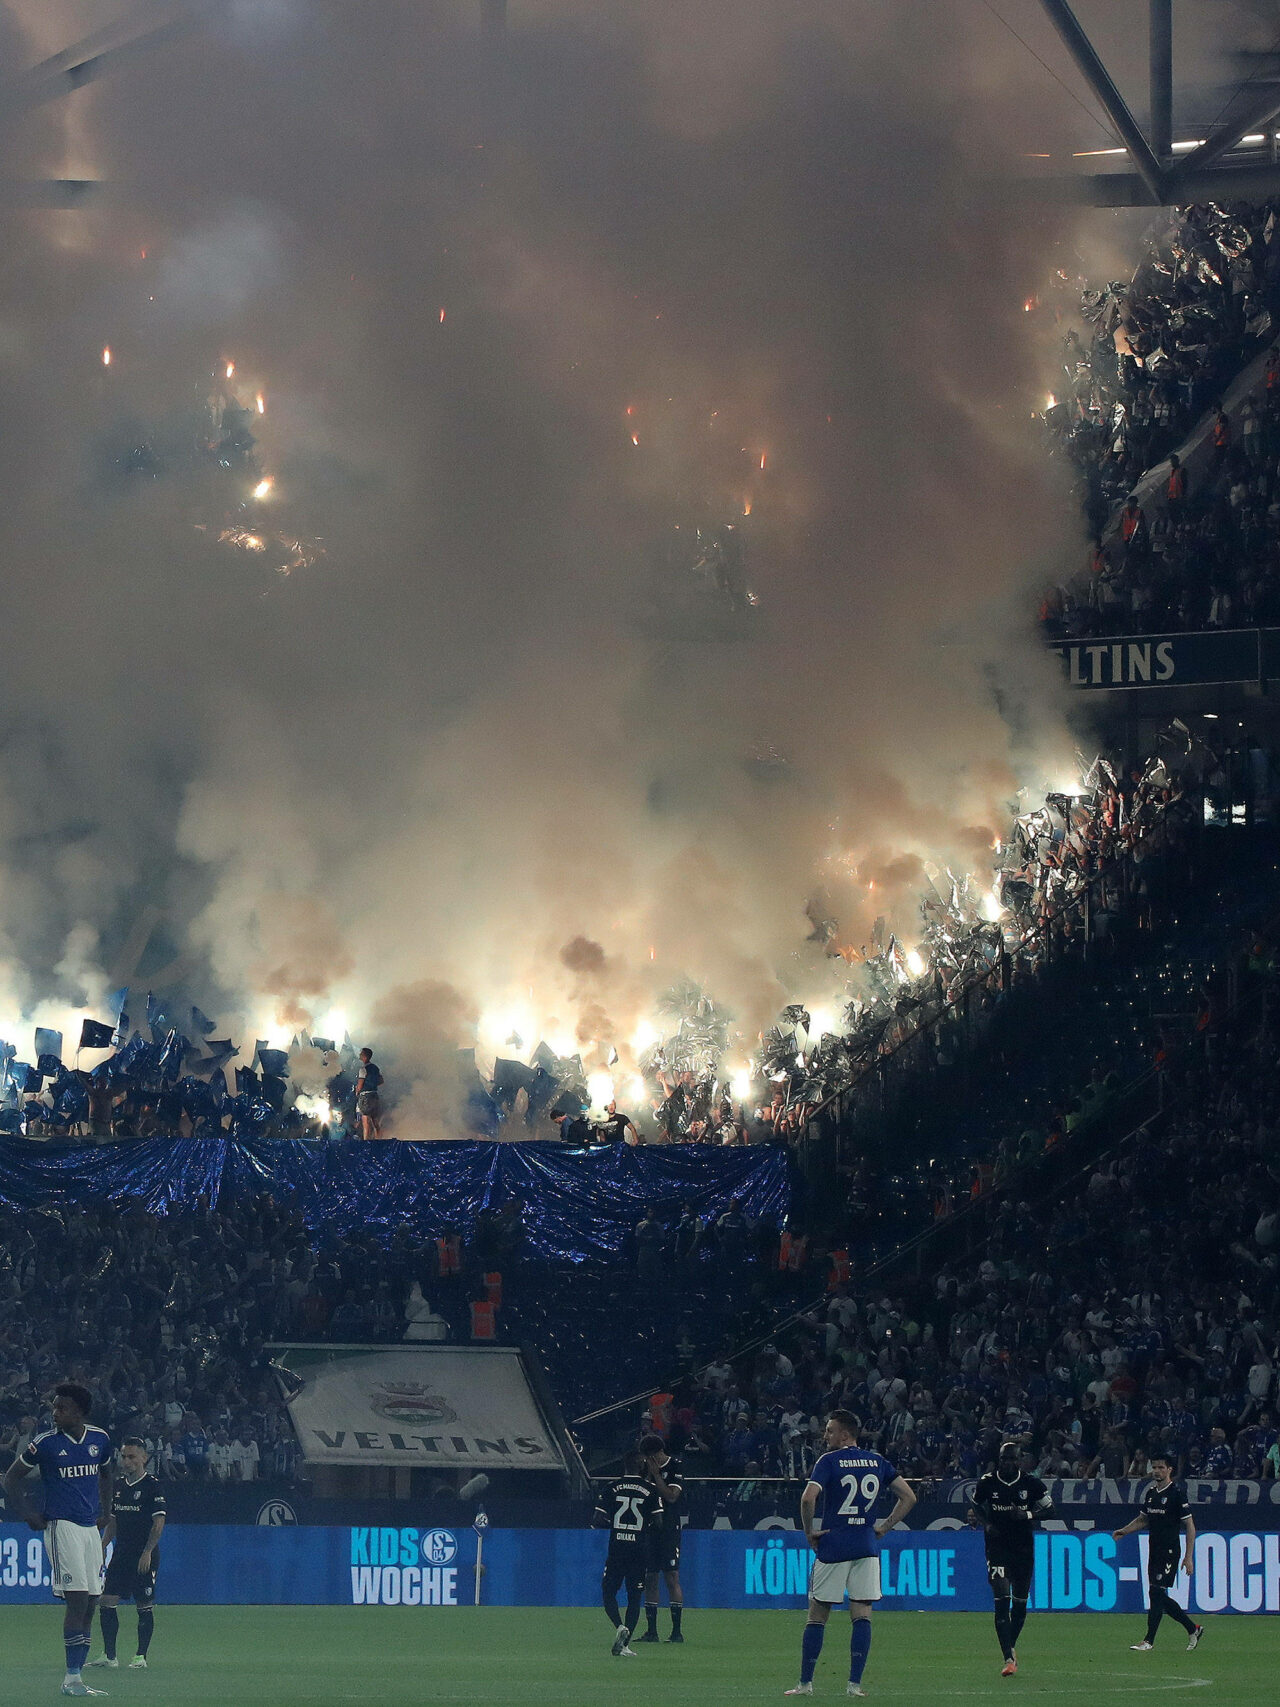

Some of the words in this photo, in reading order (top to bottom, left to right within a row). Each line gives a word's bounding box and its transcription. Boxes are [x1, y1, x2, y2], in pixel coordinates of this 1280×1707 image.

[1050, 642, 1175, 684] LTINS
[311, 1429, 545, 1455] VELTINS
[839, 1459, 869, 1468] SCHALKE
[613, 1496, 645, 1531] 25
[837, 1474, 880, 1515] 29
[351, 1527, 419, 1566] KIDS
[351, 1566, 458, 1606] WOCHE
